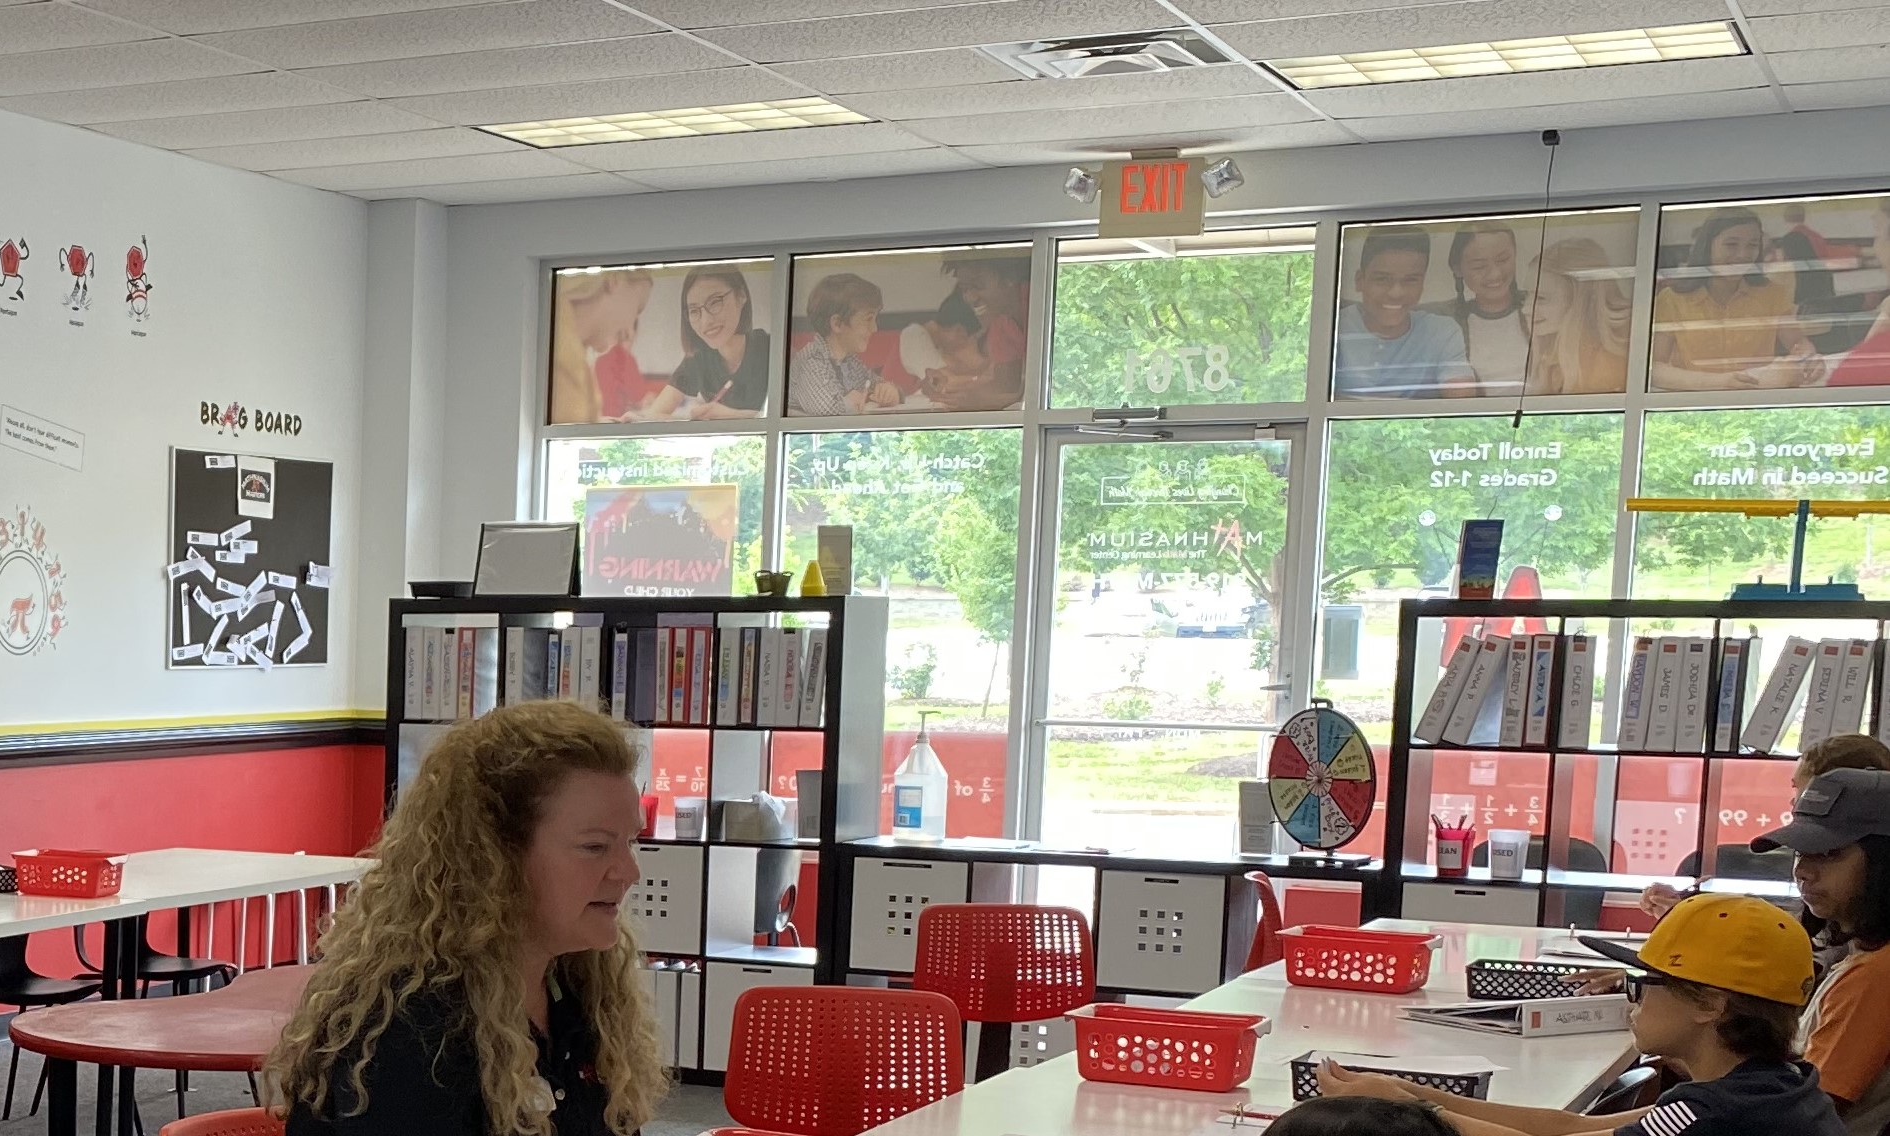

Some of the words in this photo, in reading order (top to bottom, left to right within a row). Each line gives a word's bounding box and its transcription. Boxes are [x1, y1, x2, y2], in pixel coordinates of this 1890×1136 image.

[1120, 162, 1190, 214] EXIT
[200, 401, 248, 434] BRAG
[254, 409, 302, 436] BOARD
[1572, 665, 1582, 695] CHLOE
[1660, 667, 1672, 699] JAMES
[1688, 663, 1699, 700] JOSHUA
[1775, 663, 1799, 705] NATALIE
[1845, 666, 1859, 689] WILL
[1571, 699, 1578, 707] G
[1770, 706, 1779, 715] K
[1843, 695, 1852, 703] R
